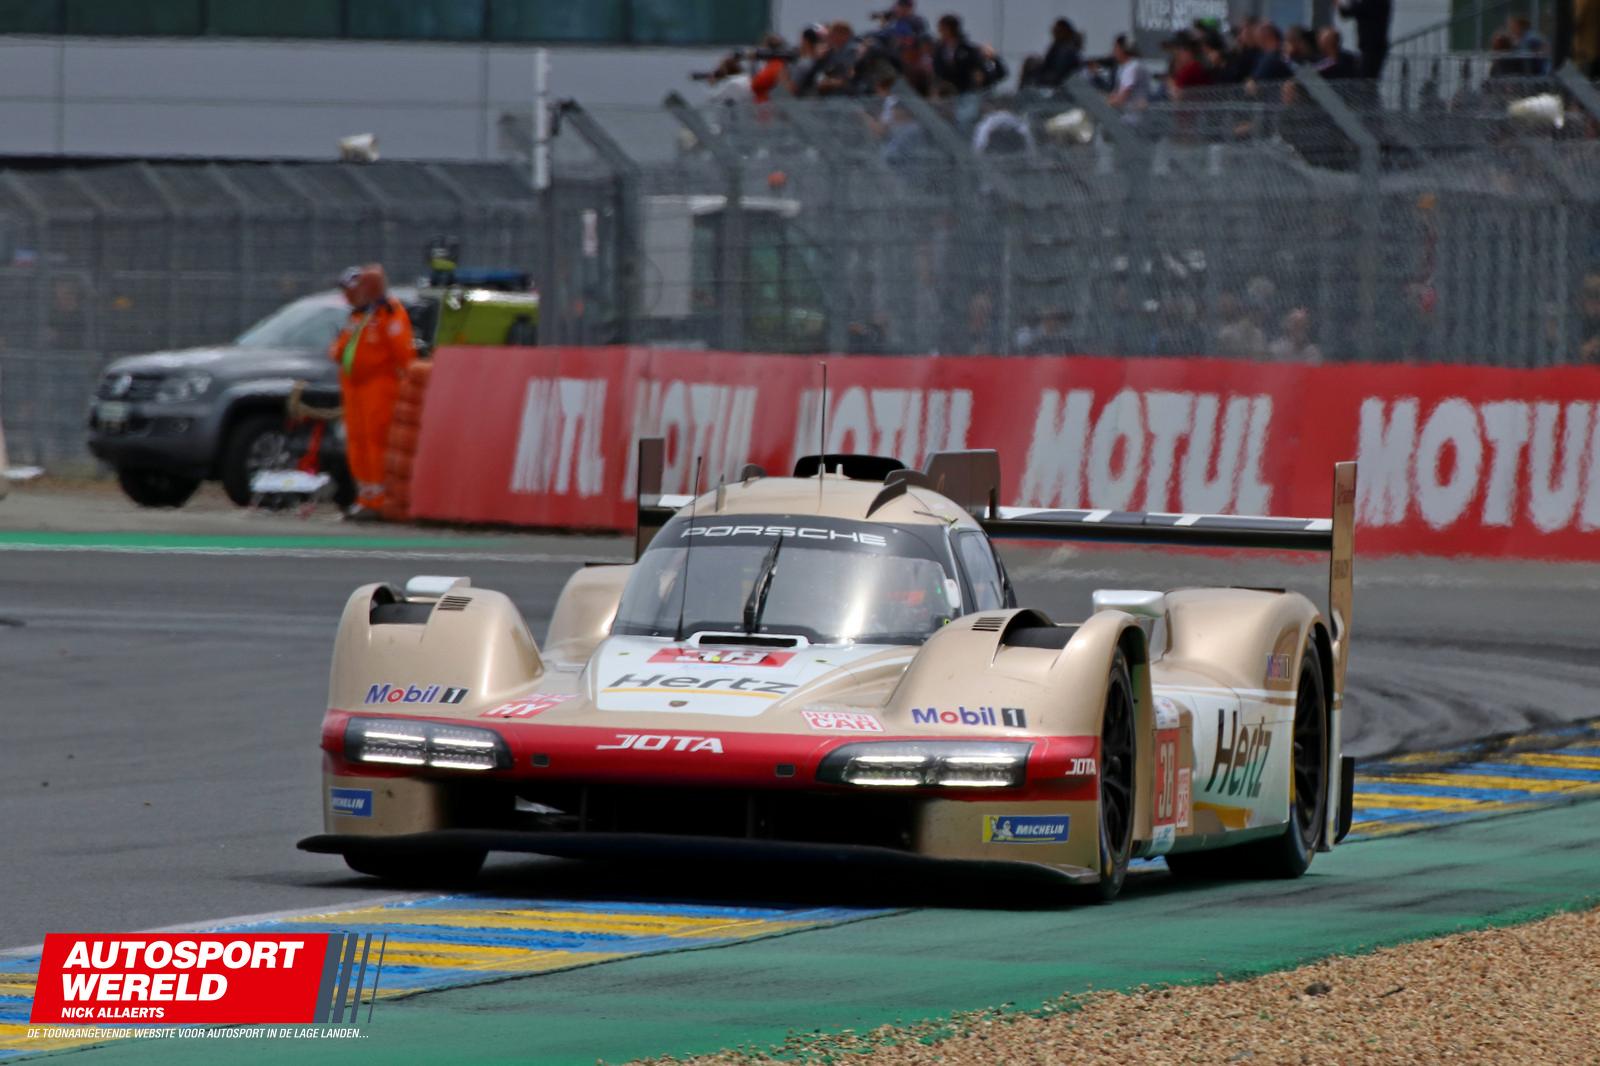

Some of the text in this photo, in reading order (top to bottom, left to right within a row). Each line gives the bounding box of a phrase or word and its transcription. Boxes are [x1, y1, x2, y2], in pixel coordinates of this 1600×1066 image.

[1018, 388, 1272, 516] MOTUL
[681, 526, 887, 547] PORSCHE
[608, 673, 799, 694] Hertz
[364, 684, 440, 704] Mobil
[811, 718, 877, 731] CAR
[912, 706, 996, 726] Mobil
[596, 734, 724, 753] JOTA
[1205, 708, 1272, 799] Hertz
[1065, 758, 1096, 775] JOTA
[1015, 824, 1065, 835] MICHELIN
